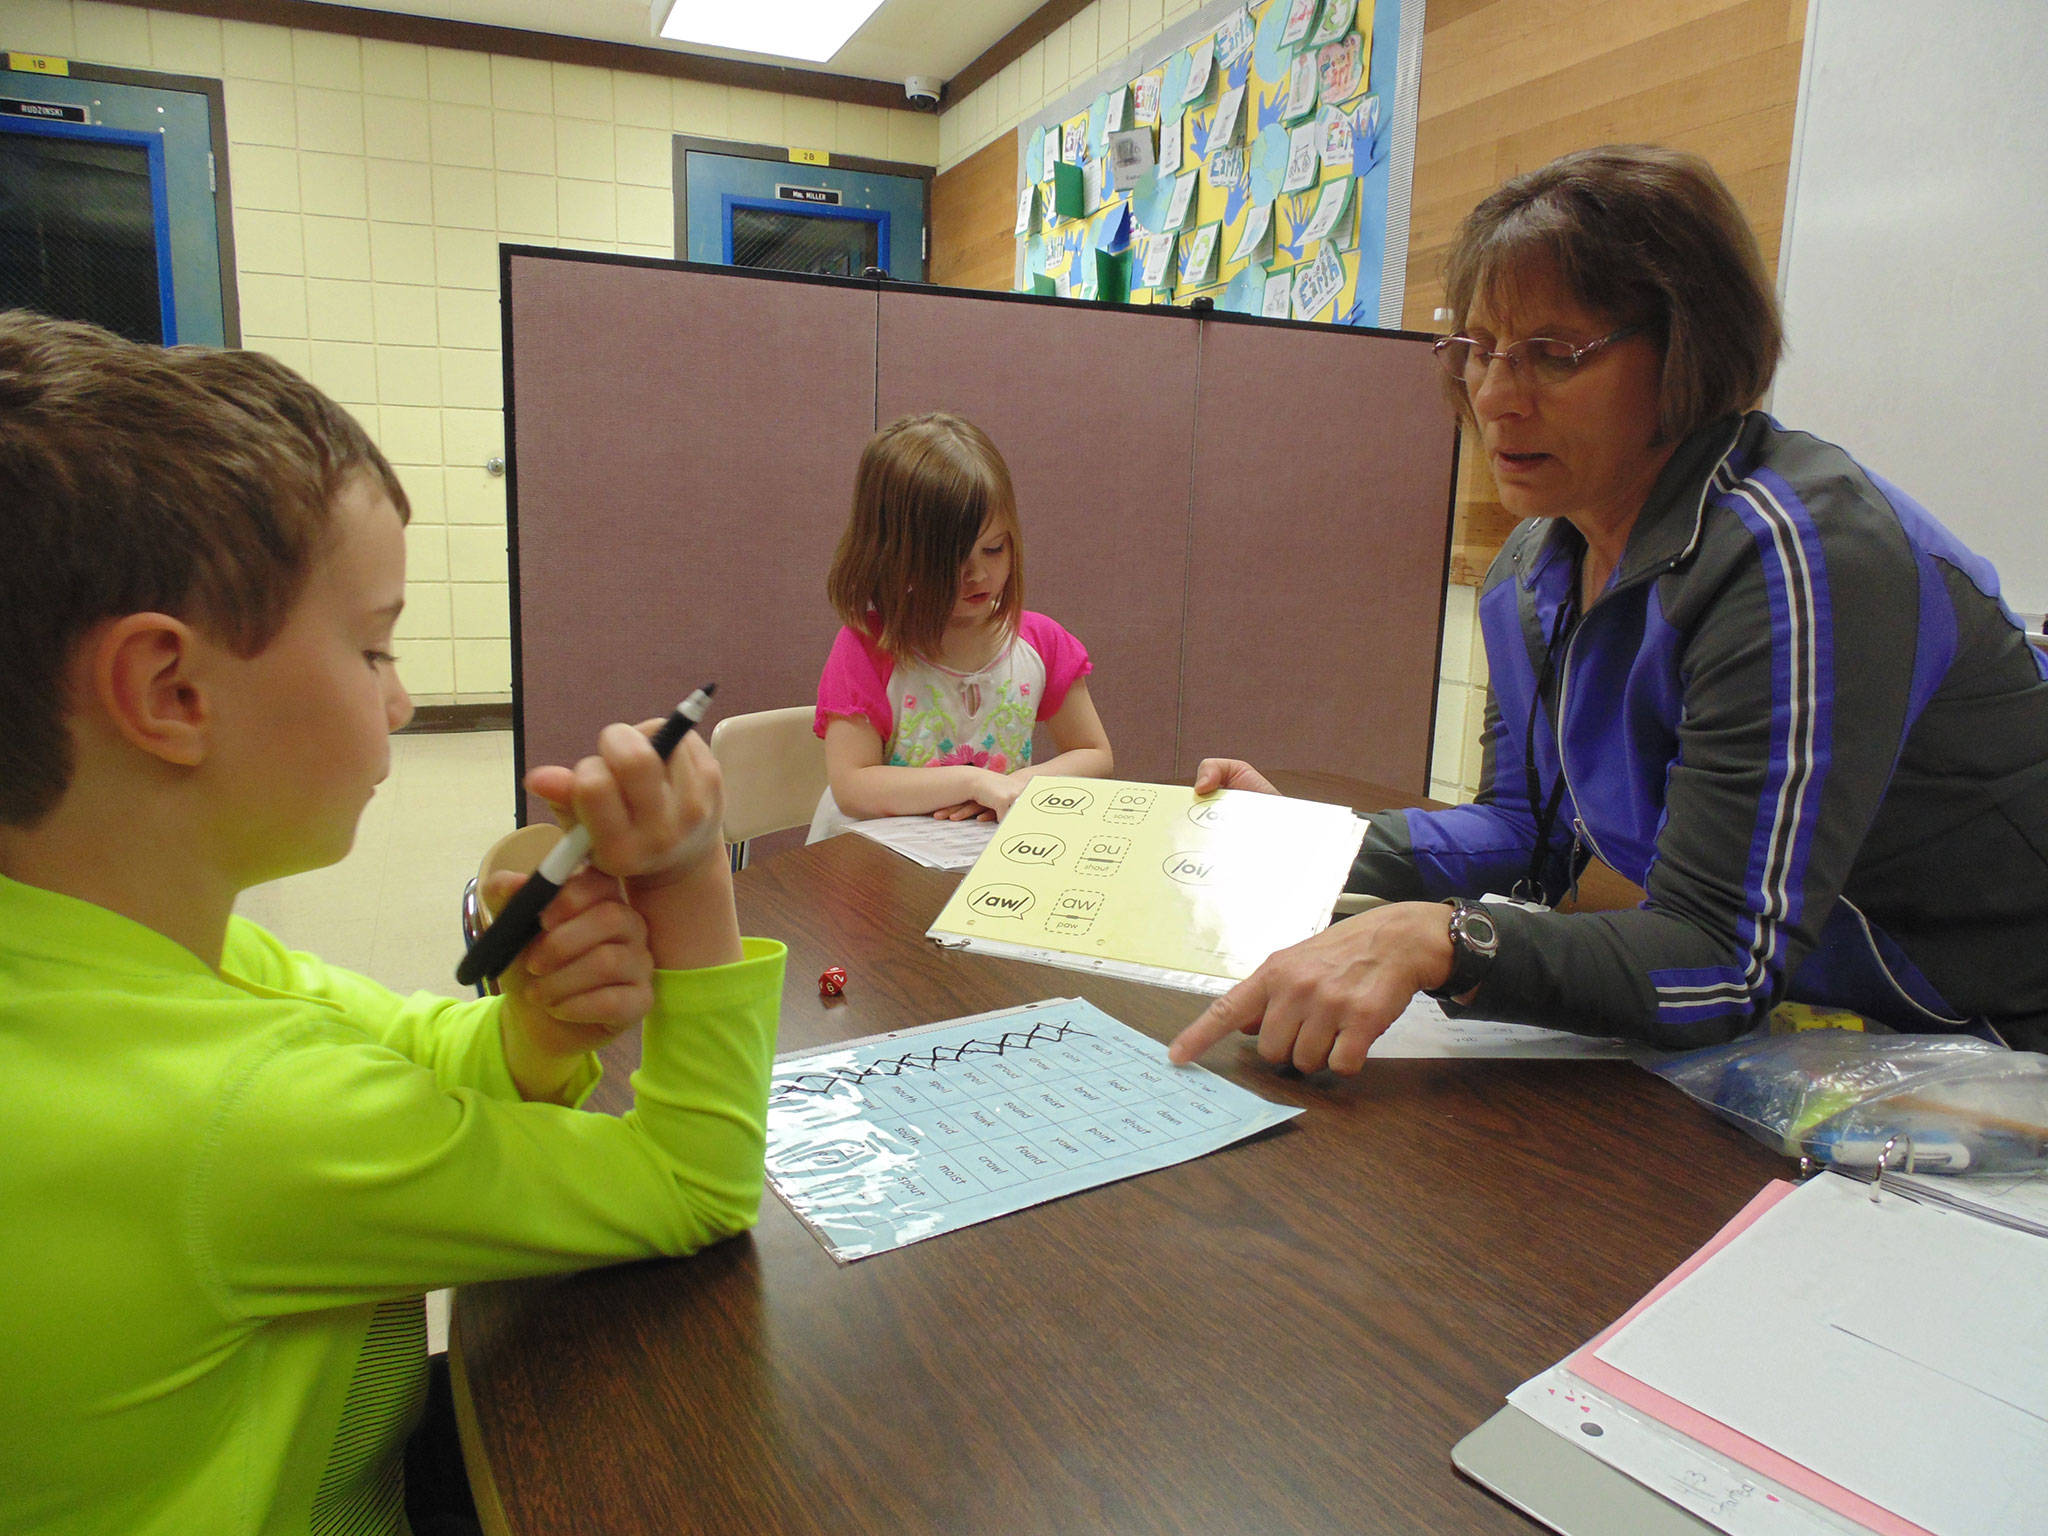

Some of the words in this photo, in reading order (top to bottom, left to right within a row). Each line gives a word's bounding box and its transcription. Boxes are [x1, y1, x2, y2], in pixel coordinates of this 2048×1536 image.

[32, 60, 46, 69] 1B
[803, 151, 815, 161] 2B
[1119, 794, 1147, 806] oo
[1007, 840, 1059, 858] /ou/
[1092, 843, 1122, 855] ou
[1083, 863, 1110, 872] shout
[1171, 858, 1214, 878] /oi/
[971, 891, 1030, 912] /aw/
[1061, 896, 1097, 912] aw
[1055, 921, 1079, 930] paw
[992, 1063, 1021, 1079] proud
[891, 1086, 919, 1104] mouth
[1040, 1093, 1066, 1109] hoist
[1004, 1101, 1034, 1119] sound
[1190, 1101, 1214, 1115] claw
[970, 1110, 998, 1128] hawk
[1120, 1117, 1152, 1135] shout
[1156, 1109, 1184, 1126] dawn
[936, 1120, 960, 1135] void
[1085, 1127, 1118, 1144] point
[894, 1127, 921, 1146] south
[1050, 1136, 1079, 1154] yawn
[1016, 1144, 1049, 1165] found
[977, 1155, 1009, 1175] crawl
[938, 1164, 968, 1186] moist
[897, 1175, 927, 1198] spout
